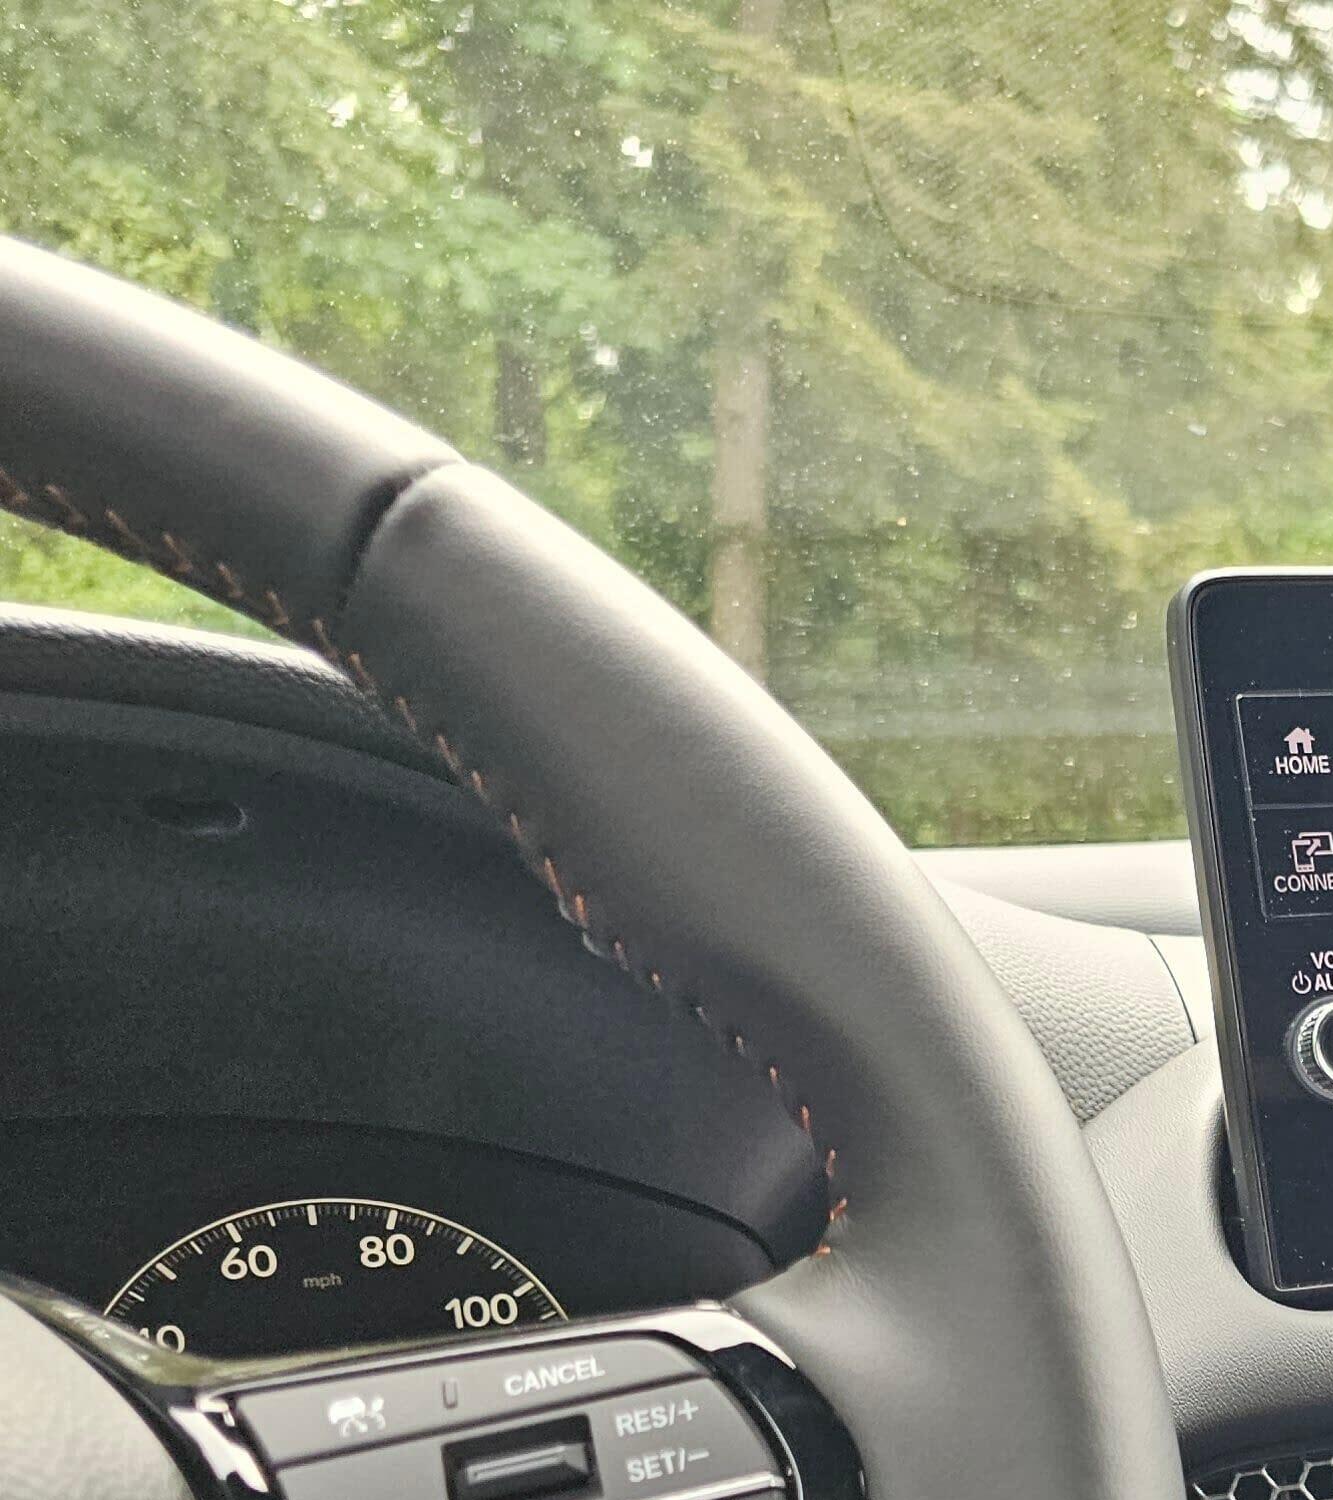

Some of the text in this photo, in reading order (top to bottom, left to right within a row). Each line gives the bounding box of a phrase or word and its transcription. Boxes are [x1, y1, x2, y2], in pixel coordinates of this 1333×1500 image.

[1275, 754, 1331, 775] HOME
[220, 1245, 278, 1280] 60
[358, 1233, 415, 1269] 80
[302, 1272, 343, 1290] mph
[444, 1293, 518, 1329] 100
[504, 1355, 606, 1397] CANCEL
[615, 1399, 699, 1437] RES/+
